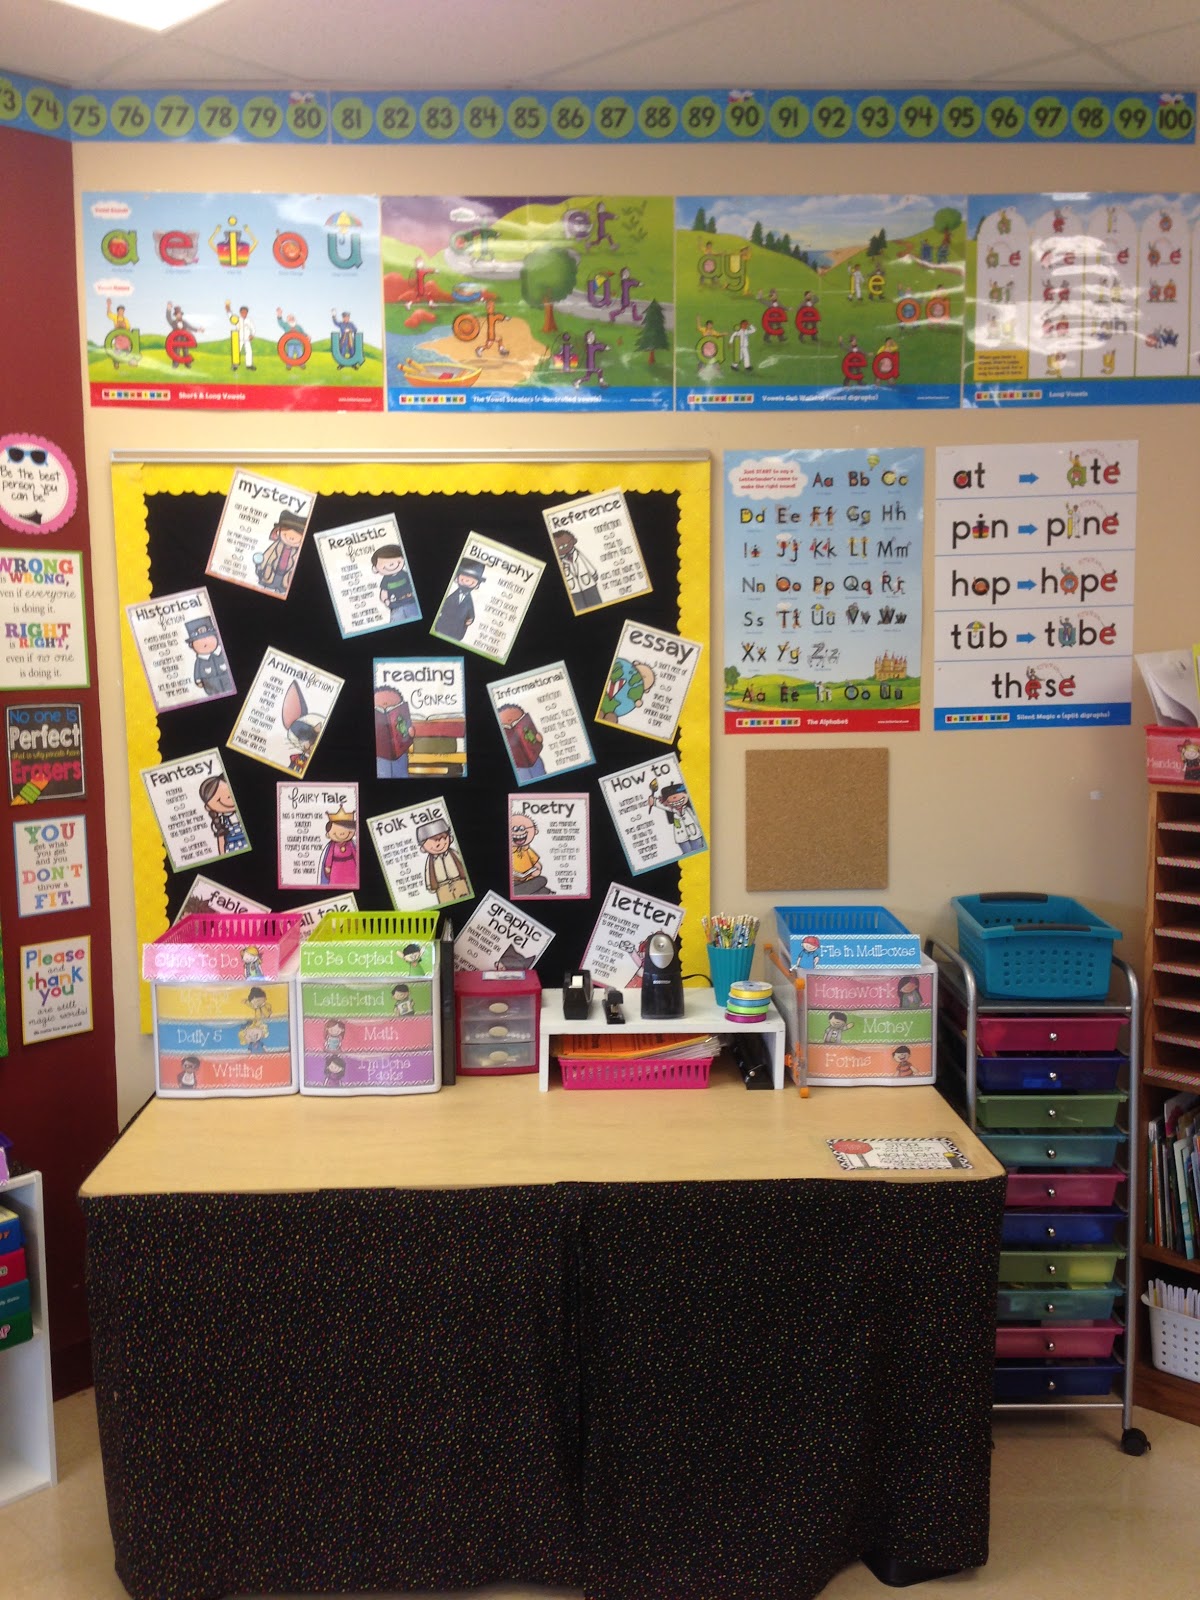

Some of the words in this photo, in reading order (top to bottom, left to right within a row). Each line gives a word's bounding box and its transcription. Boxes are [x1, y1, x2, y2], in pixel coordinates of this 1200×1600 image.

[30, 98, 58, 122] 74
[73, 106, 101, 127] 75
[118, 106, 145, 127] 76
[160, 106, 189, 127] 77
[205, 106, 232, 127] 78
[249, 106, 277, 128] 79
[292, 106, 322, 129] 80
[341, 107, 362, 130] 81
[382, 107, 410, 130] 82
[426, 107, 452, 129] 83
[469, 107, 497, 128] 84
[513, 107, 541, 129] 85
[557, 107, 585, 129] 86
[600, 107, 628, 129] 87
[645, 106, 672, 128] 88
[688, 106, 716, 128] 89
[731, 105, 760, 127] 90
[778, 106, 799, 128] 91
[818, 106, 846, 128] 92
[862, 106, 890, 128] 93
[904, 106, 933, 128] 94
[948, 106, 975, 128] 95
[991, 106, 1018, 128] 96
[1034, 106, 1062, 128] 97
[1078, 106, 1103, 129] 98
[1119, 107, 1147, 129] 99
[1158, 107, 1193, 130] 100
[18, 468, 34, 480] the
[39, 470, 61, 482] best
[953, 462, 985, 489] at
[2, 481, 35, 492] person
[40, 483, 58, 496] you
[11, 492, 28, 501] can
[238, 479, 308, 513] mystery
[552, 498, 622, 529] Reference
[328, 526, 387, 550] Realistic
[952, 513, 1008, 549] pin
[0, 557, 74, 574] WRONG
[469, 545, 535, 583] Biography
[25, 589, 76, 603] everyone
[951, 570, 1011, 605] hop
[13, 603, 20, 613] is
[22, 604, 45, 616] doing
[135, 596, 203, 622] Historical
[5, 623, 71, 639] RIGHT
[951, 621, 1007, 650] tub
[9, 641, 16, 649] is
[629, 630, 694, 665] essay
[6, 655, 25, 663] even
[27, 653, 34, 663] if
[54, 654, 74, 662] one
[20, 669, 26, 677] is
[28, 668, 52, 680] doing
[267, 656, 308, 682] Animal
[383, 666, 455, 686] reading
[495, 672, 565, 701] Informational
[991, 672, 1076, 700] these
[10, 709, 30, 724] No
[34, 711, 61, 723] one
[66, 708, 78, 722] is
[819, 718, 849, 726] Alphabet
[9, 723, 80, 750] Perfect
[11, 759, 82, 784] Erasers
[150, 759, 213, 787] Fantasy
[610, 770, 646, 793] How
[650, 762, 671, 778] to
[522, 801, 575, 818] Poetry
[375, 817, 407, 837] folk
[410, 807, 444, 826] tale
[24, 822, 76, 845] YOU
[33, 843, 46, 852] get
[48, 841, 69, 849] what
[37, 850, 51, 859] you
[53, 848, 67, 857] get
[52, 856, 68, 865] you
[22, 864, 82, 885] DON'T
[37, 883, 61, 892] throw
[209, 890, 249, 914] fable
[611, 890, 677, 927] letter
[488, 902, 542, 943] graphic
[488, 917, 530, 950] novel
[26, 949, 85, 969] Please
[303, 951, 323, 966] To
[326, 951, 343, 966] Be
[347, 951, 394, 969] Copied
[820, 945, 841, 958] File
[856, 944, 916, 958] Mailboxes
[198, 954, 217, 968] To
[220, 954, 239, 968] Do
[27, 965, 84, 991] thank
[39, 983, 75, 1007] you
[313, 992, 385, 1006] Letterland
[814, 983, 896, 999] Homework
[363, 1026, 399, 1041] Math
[862, 1018, 913, 1037] Money
[177, 1028, 209, 1047] Daily
[380, 1056, 411, 1069] Done
[825, 1053, 872, 1068] Forms
[212, 1063, 263, 1081] Writing
[367, 1069, 404, 1082] Packs
